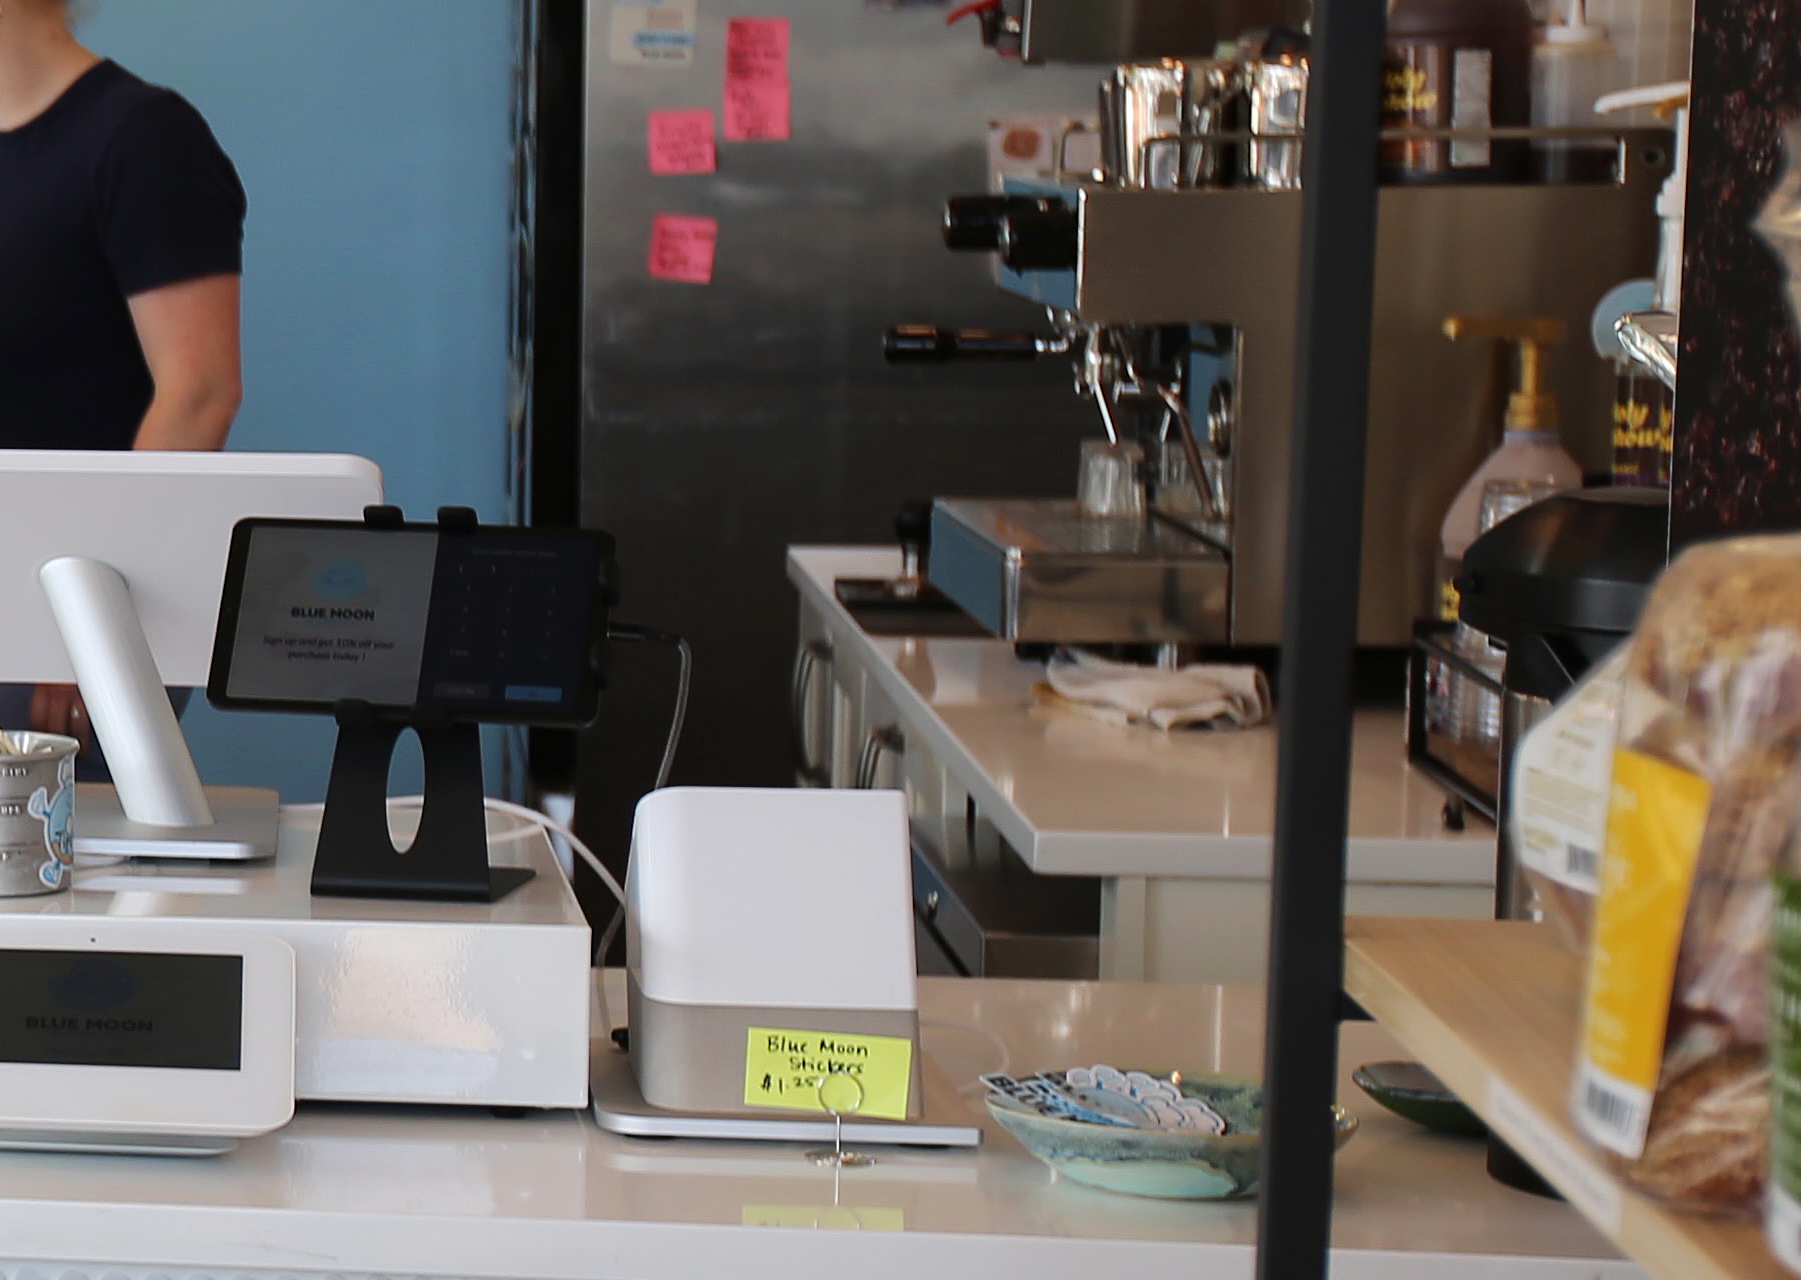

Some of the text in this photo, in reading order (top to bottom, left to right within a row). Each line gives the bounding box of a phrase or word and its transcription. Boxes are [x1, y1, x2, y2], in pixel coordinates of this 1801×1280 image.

[291, 607, 376, 622] BLUE MOON
[25, 1016, 154, 1033] BLUE MOON
[767, 1035, 869, 1058] Blue Moon
[789, 1057, 865, 1075] Stickers
